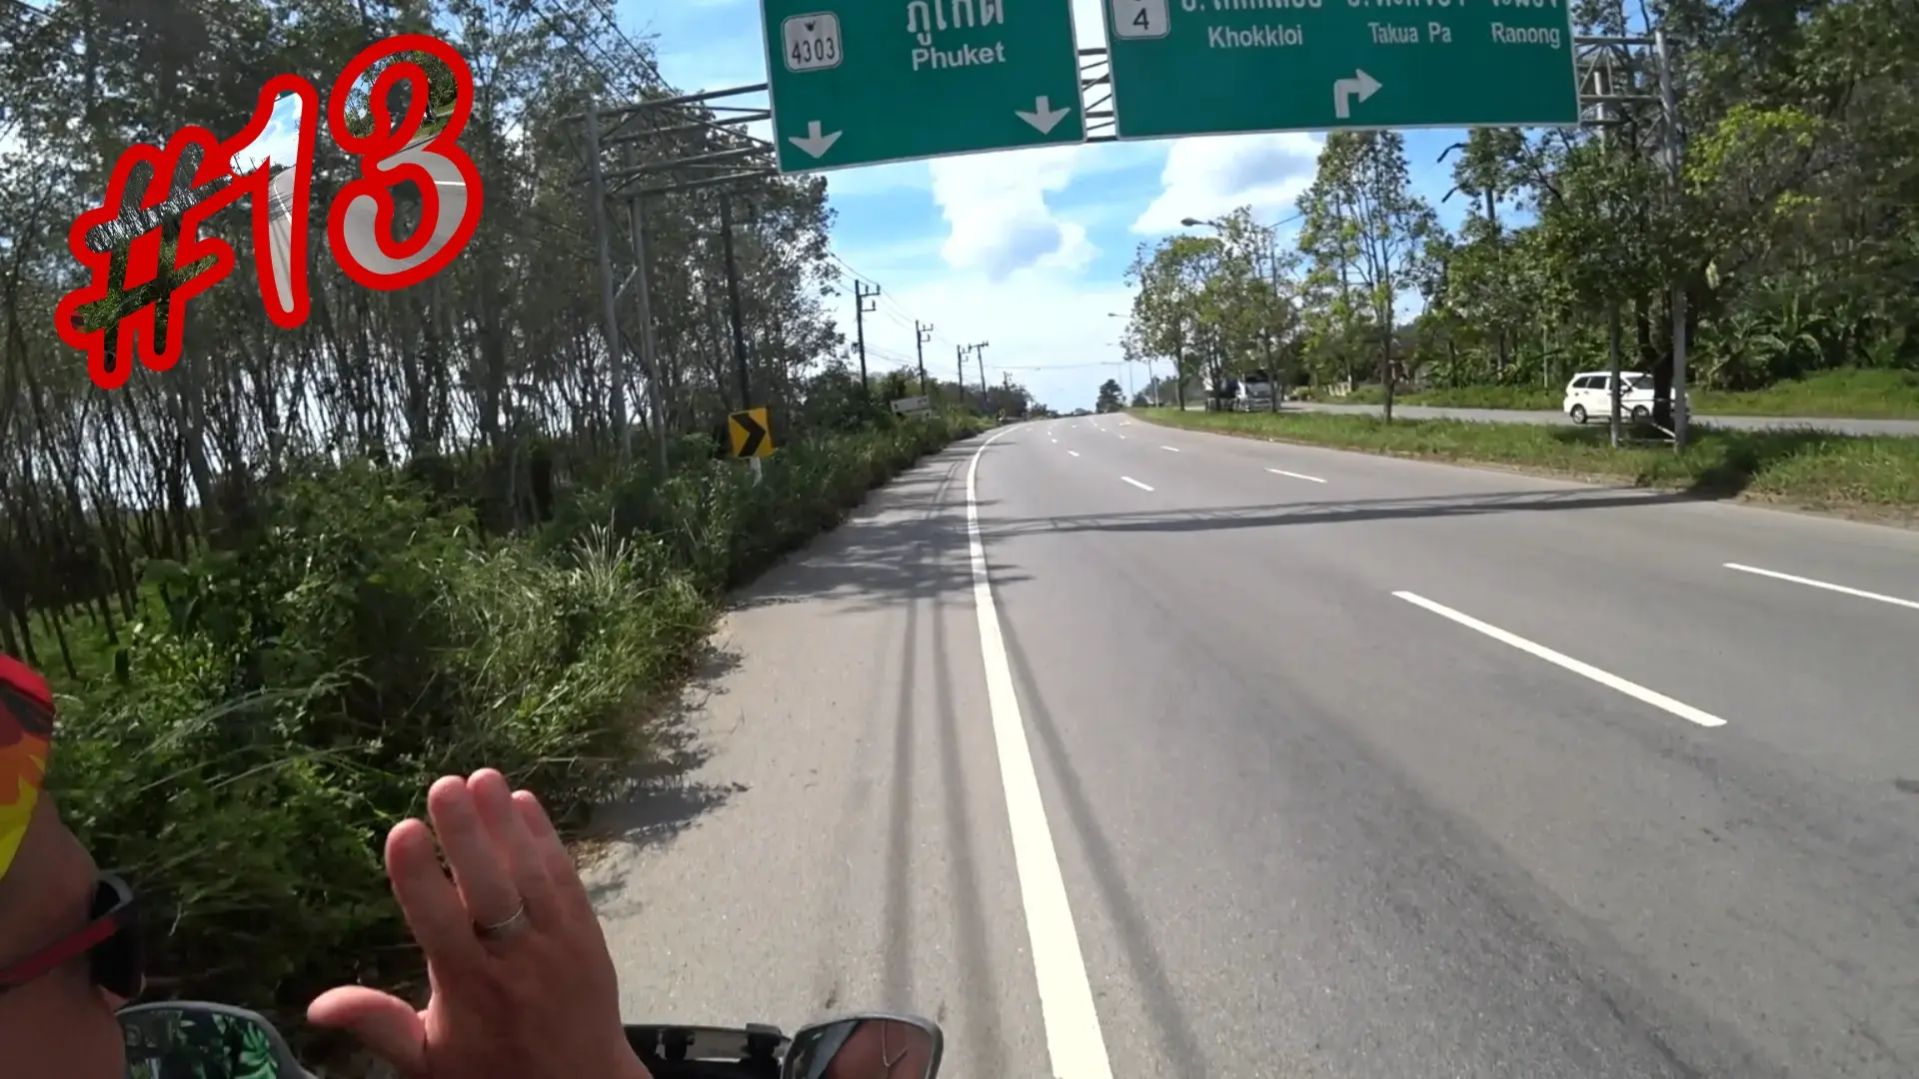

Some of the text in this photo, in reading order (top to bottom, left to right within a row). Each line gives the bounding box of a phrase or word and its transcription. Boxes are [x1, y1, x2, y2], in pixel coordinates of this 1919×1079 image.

[907, 0, 1004, 46] ภูเกต
[1133, 8, 1149, 30] 4
[1207, 24, 1304, 48] Khokkloi
[1368, 22, 1452, 44] Takua Pa
[1491, 22, 1560, 49] Ranong
[791, 37, 835, 64] 4303
[912, 41, 1006, 71] Phuket
